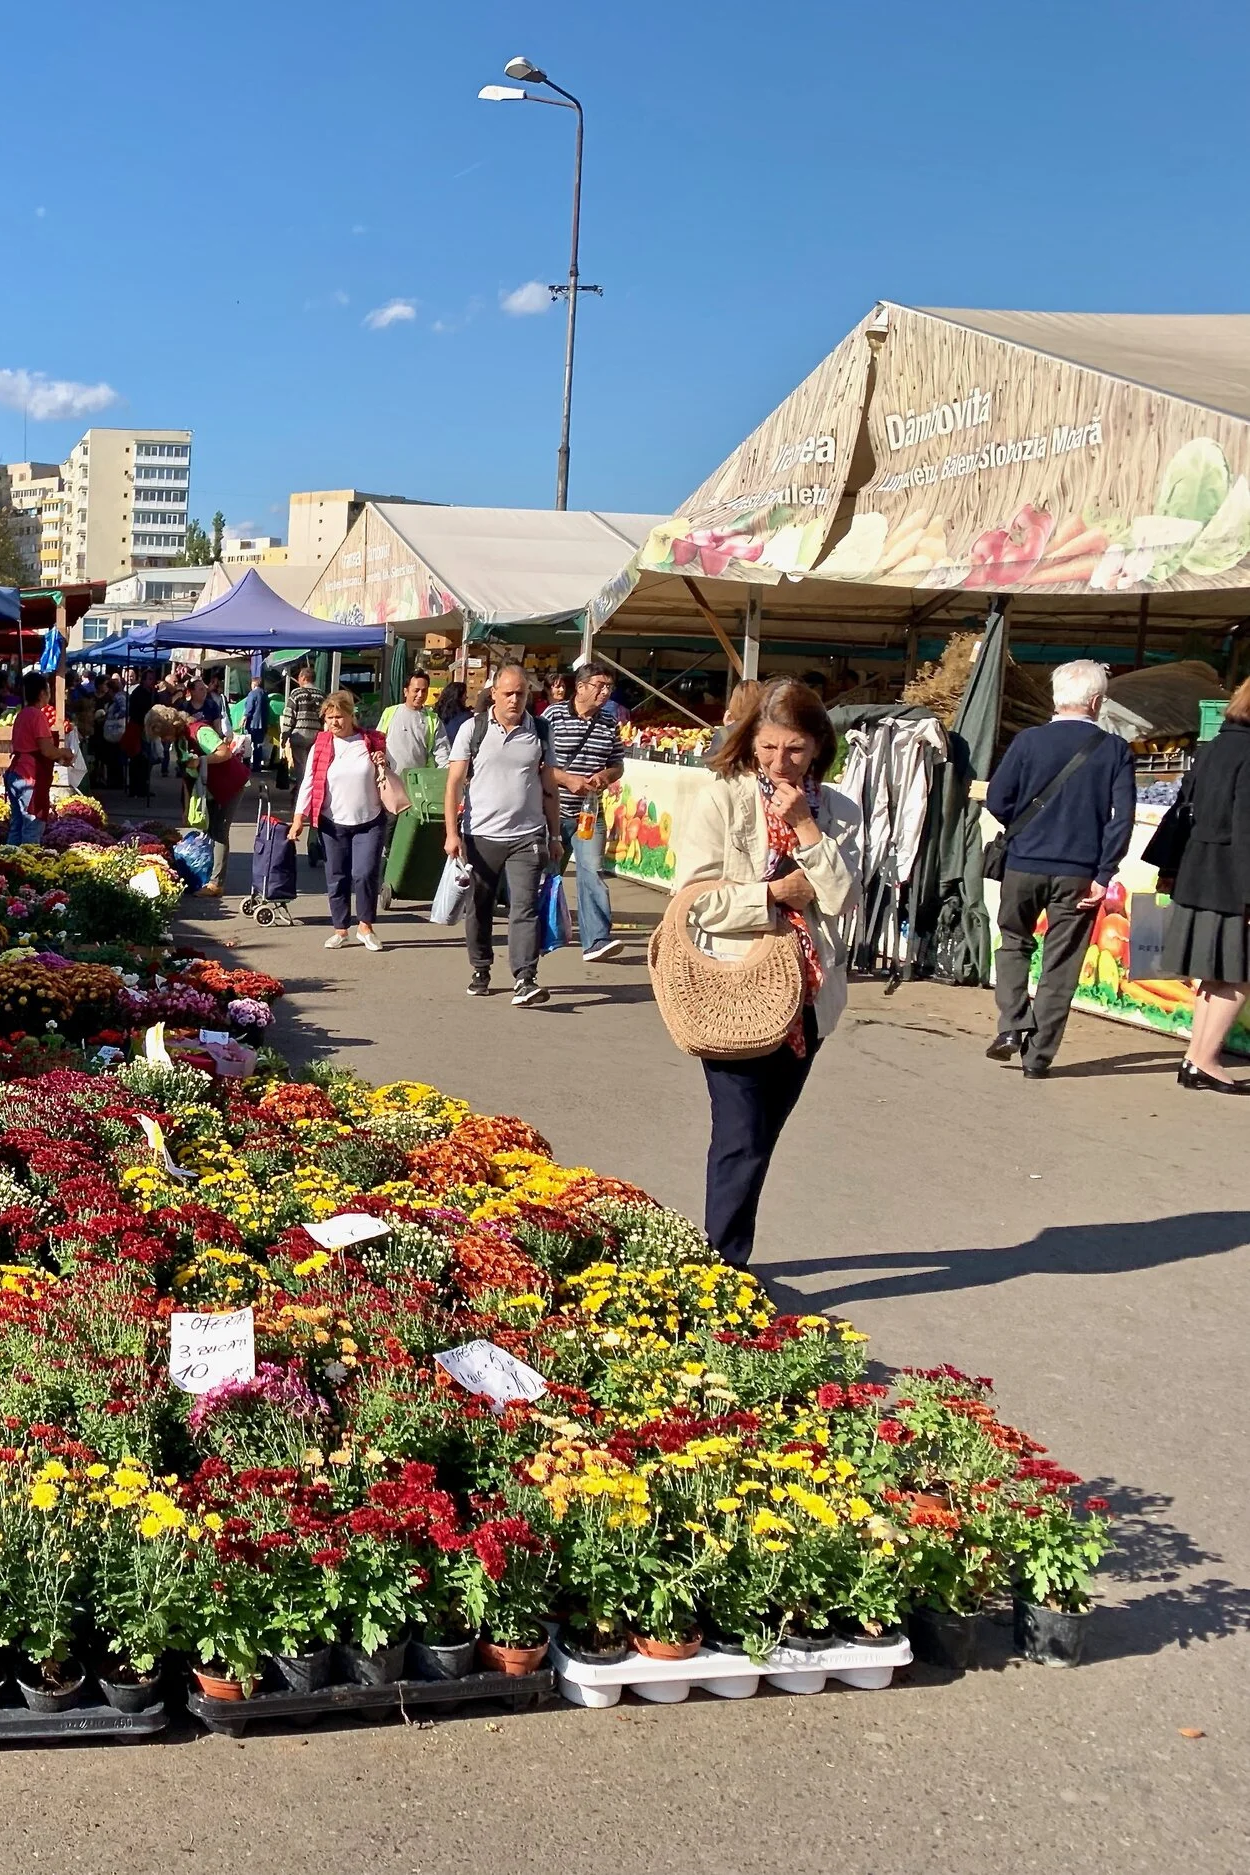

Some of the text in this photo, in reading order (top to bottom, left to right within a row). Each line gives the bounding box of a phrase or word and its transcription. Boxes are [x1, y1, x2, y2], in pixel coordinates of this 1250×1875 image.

[978, 432, 1046, 471] Slobozia
[178, 1344, 192, 1359] 3
[175, 1362, 209, 1380] 10
